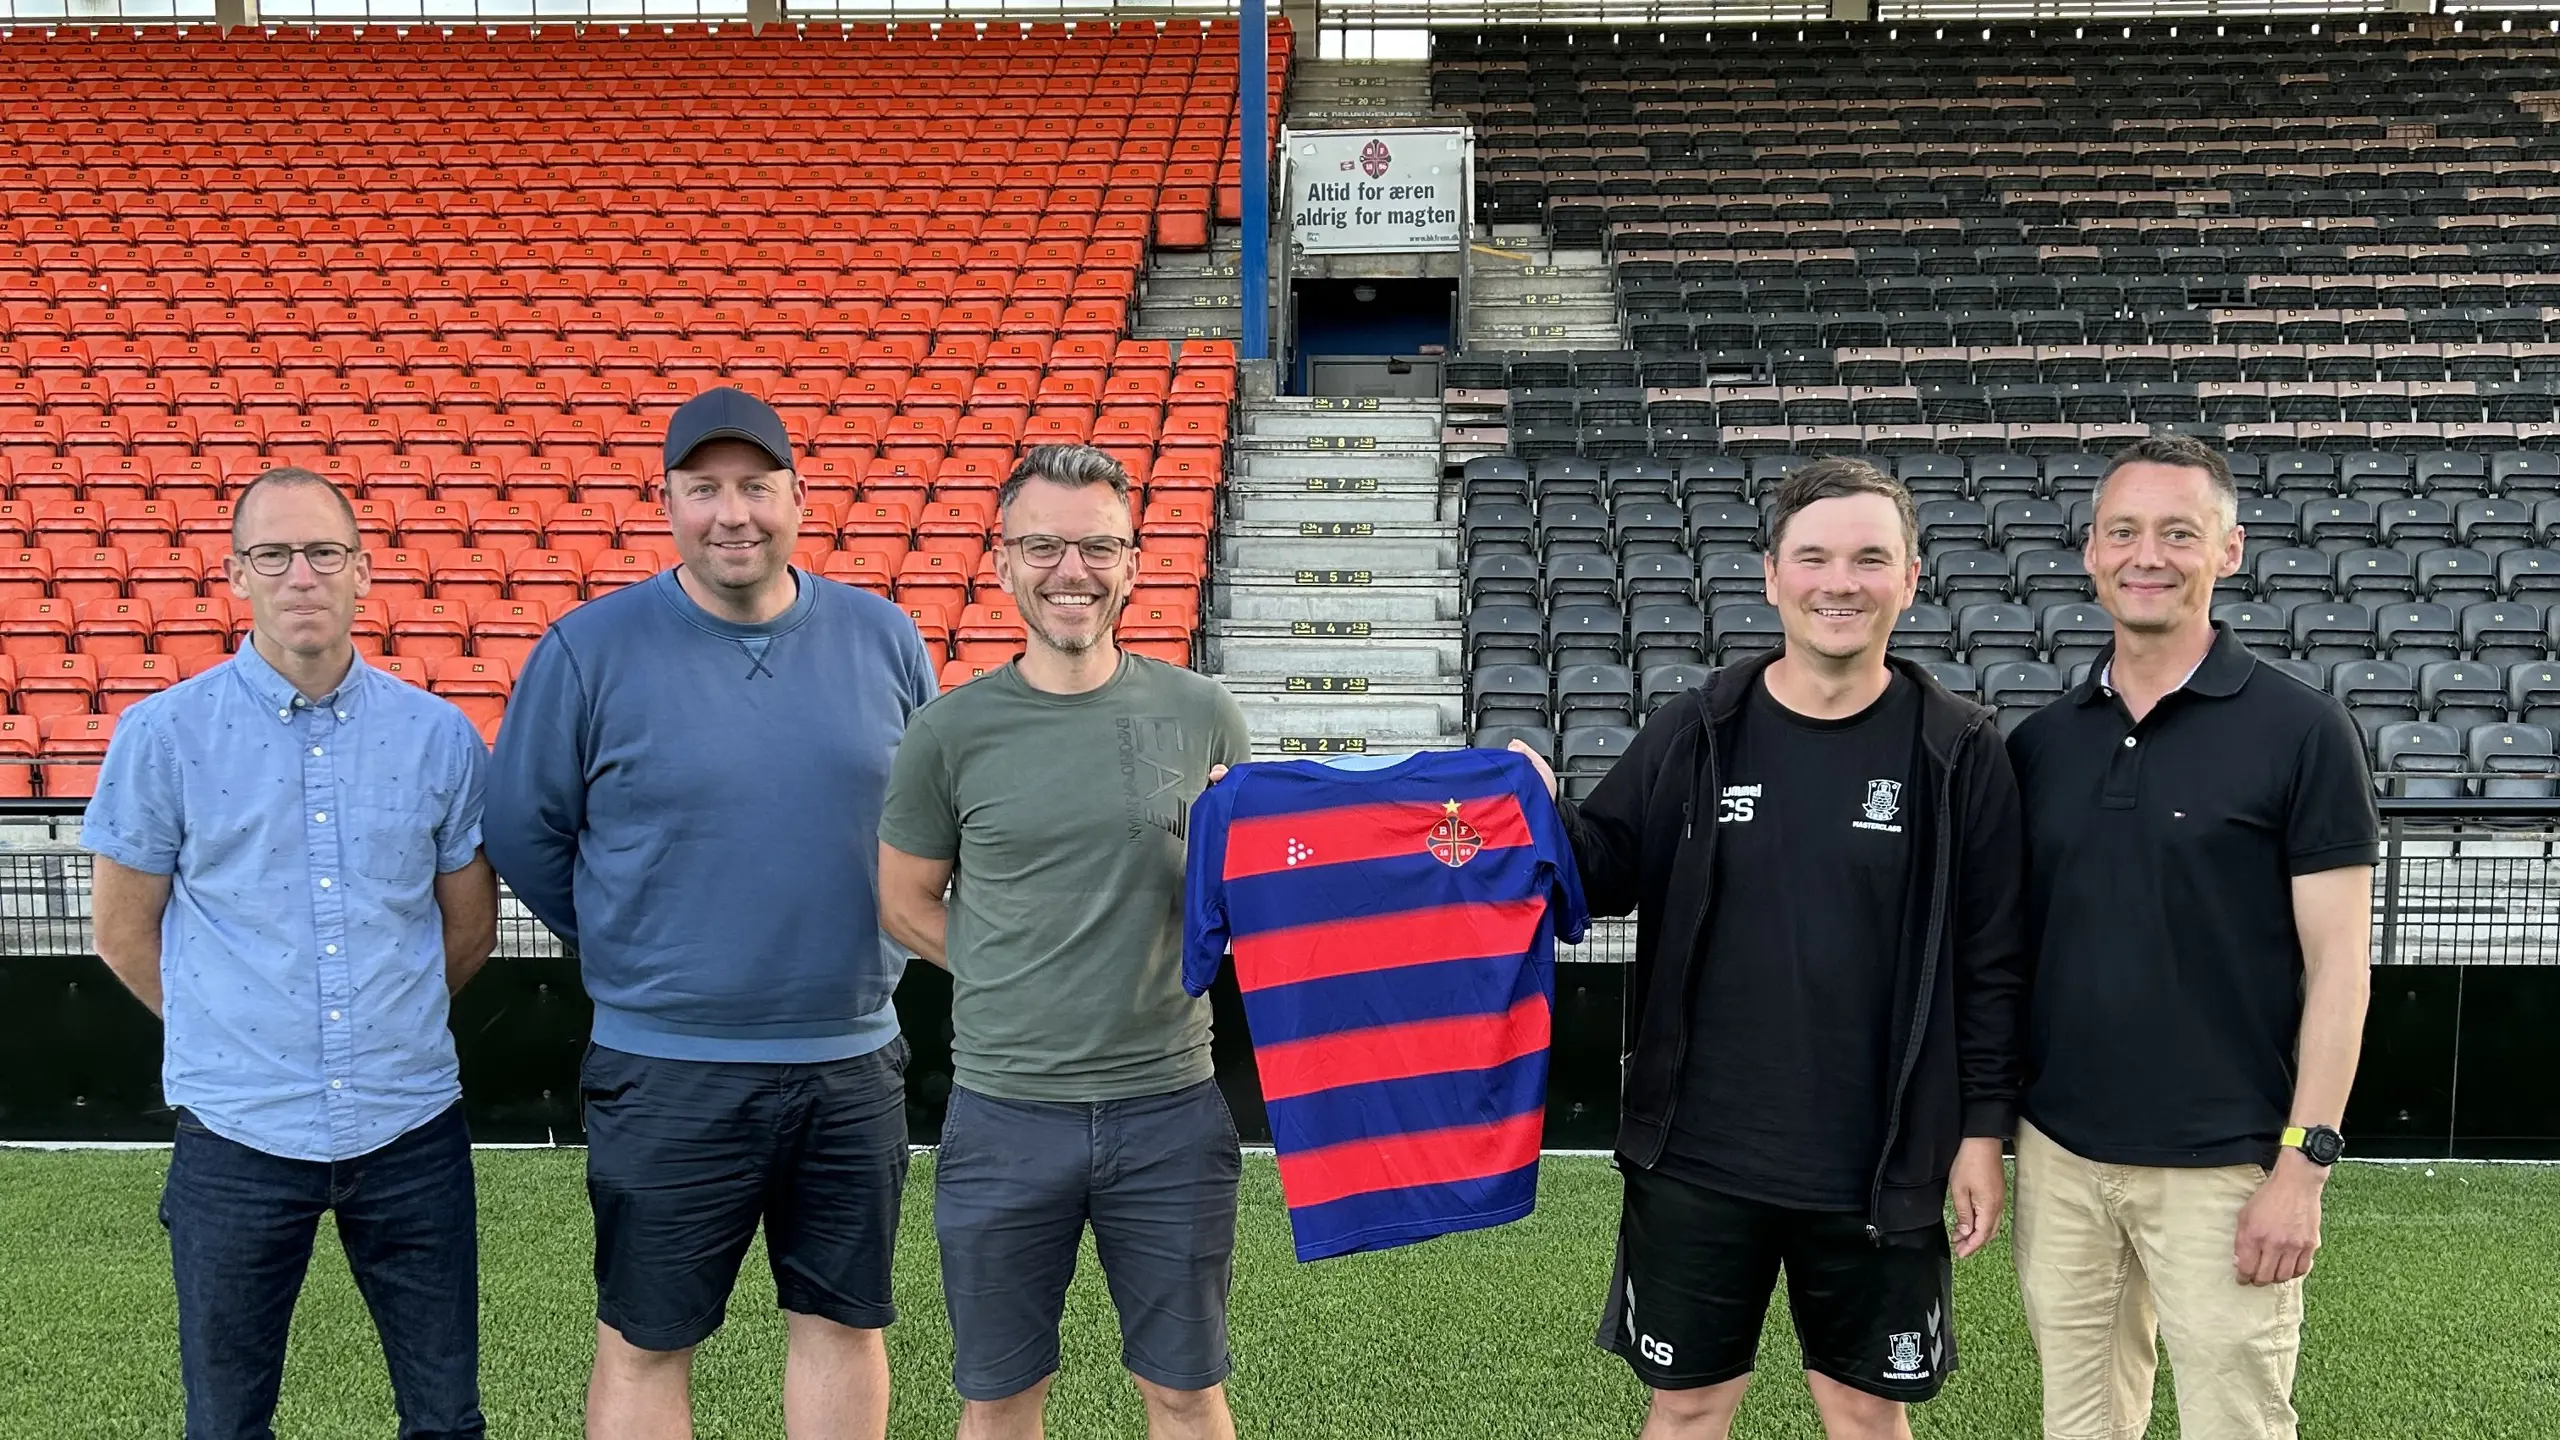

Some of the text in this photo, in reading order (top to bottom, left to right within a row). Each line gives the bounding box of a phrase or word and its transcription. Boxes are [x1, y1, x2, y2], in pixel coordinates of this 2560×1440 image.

[1308, 182, 1435, 201] Altid for æren
[1296, 206, 1455, 229] aldrig for magten
[1223, 267, 1234, 275] 13
[1524, 267, 1535, 275] 13
[1217, 296, 1228, 305] 12
[1526, 295, 1537, 303] 12
[1212, 328, 1221, 336] 11
[1529, 327, 1537, 335] 11
[1342, 399, 1349, 409] 9
[1338, 438, 1345, 448] 8
[1338, 479, 1346, 489] 7
[1302, 523, 1317, 531] 1-34
[1332, 523, 1341, 534] 6
[1356, 523, 1371, 531] 1-32
[1329, 572, 1338, 582] 5
[1326, 623, 1336, 633] 4
[1322, 679, 1332, 689] 3
[1318, 740, 1328, 751] 2
[1339, 743, 1345, 751] F
[1722, 783, 1762, 797] ummel
[1439, 826, 1469, 835] B F
[1852, 820, 1902, 833] MASTERCLASS
[1640, 1334, 1674, 1367] CS
[1883, 1370, 1930, 1380] MASTERCLASS
